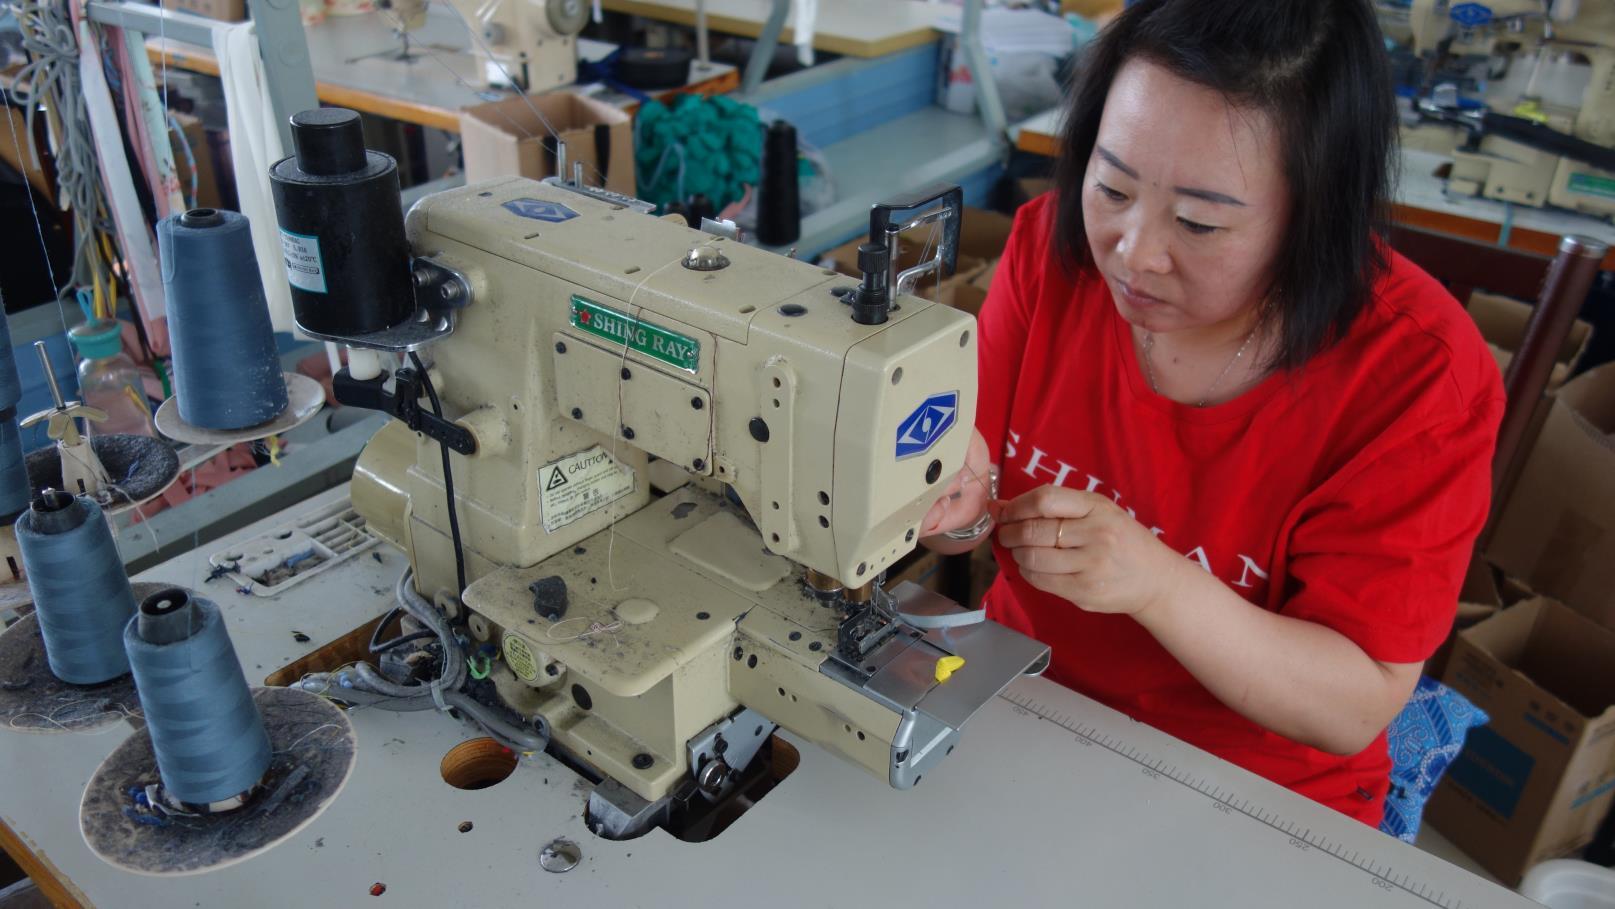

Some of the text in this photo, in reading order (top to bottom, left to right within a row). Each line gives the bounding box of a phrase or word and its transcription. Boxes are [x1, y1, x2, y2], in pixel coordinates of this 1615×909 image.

[593, 313, 688, 361] SHING RAY
[1005, 429, 1269, 588] SHAN
[1142, 768, 1160, 780] 350
[1213, 802, 1231, 814] 300
[1289, 839, 1310, 851] 250
[1371, 876, 1394, 892] 200
